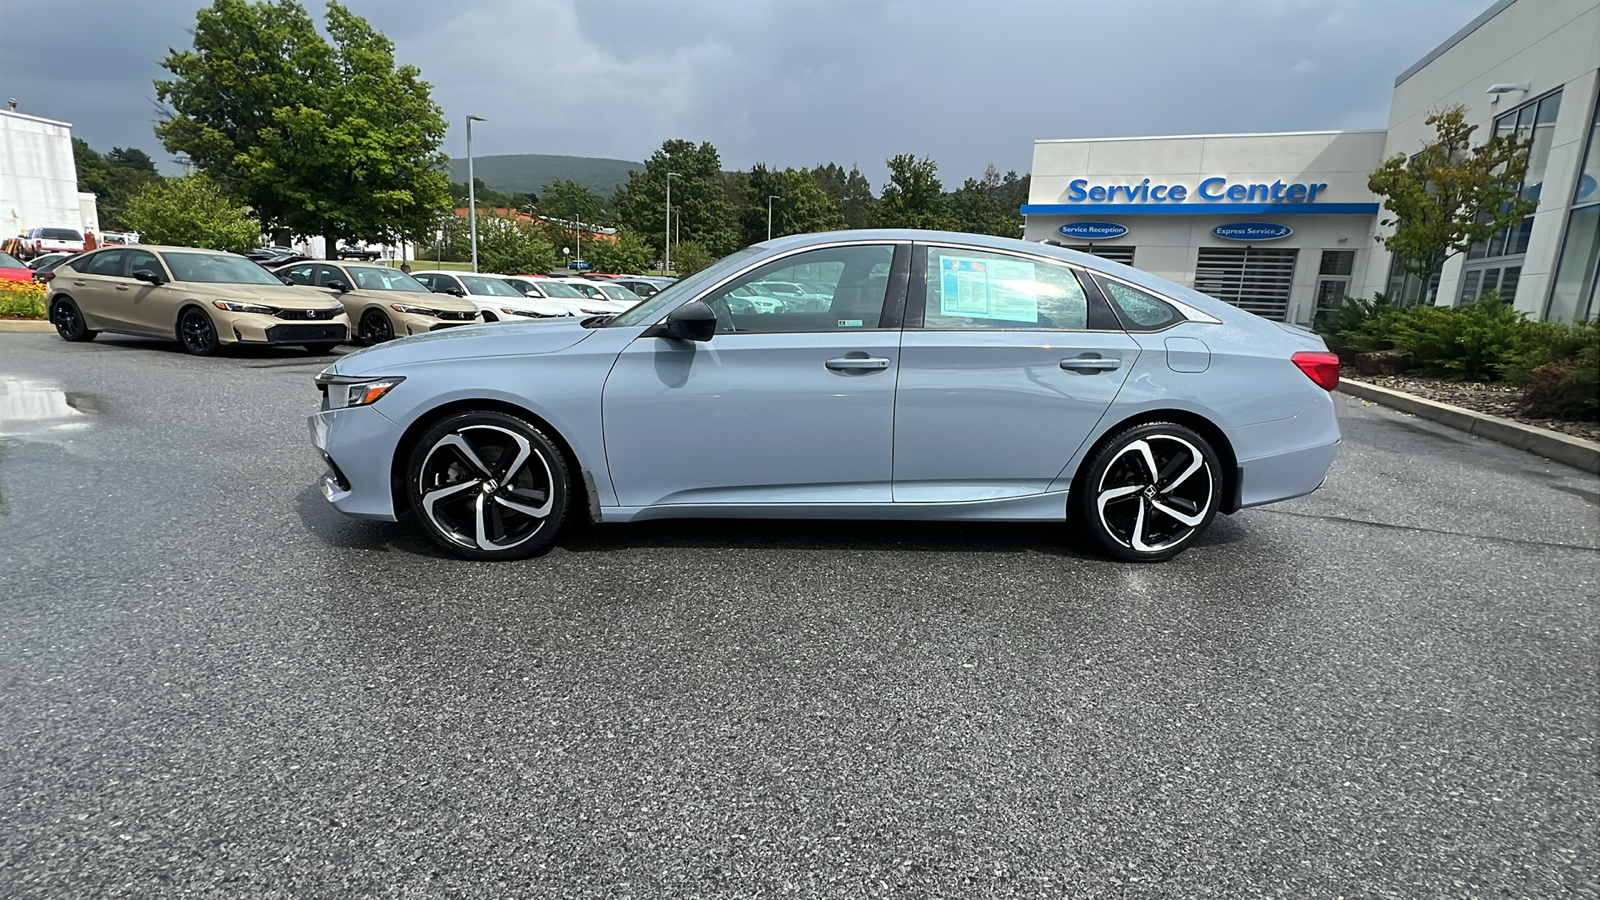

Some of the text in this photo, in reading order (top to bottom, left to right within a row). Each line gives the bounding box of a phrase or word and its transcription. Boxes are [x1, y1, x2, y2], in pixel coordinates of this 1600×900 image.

[1068, 177, 1328, 202] Service Center
[1088, 226, 1124, 234] Reception
[1216, 227, 1276, 235] Express Service
